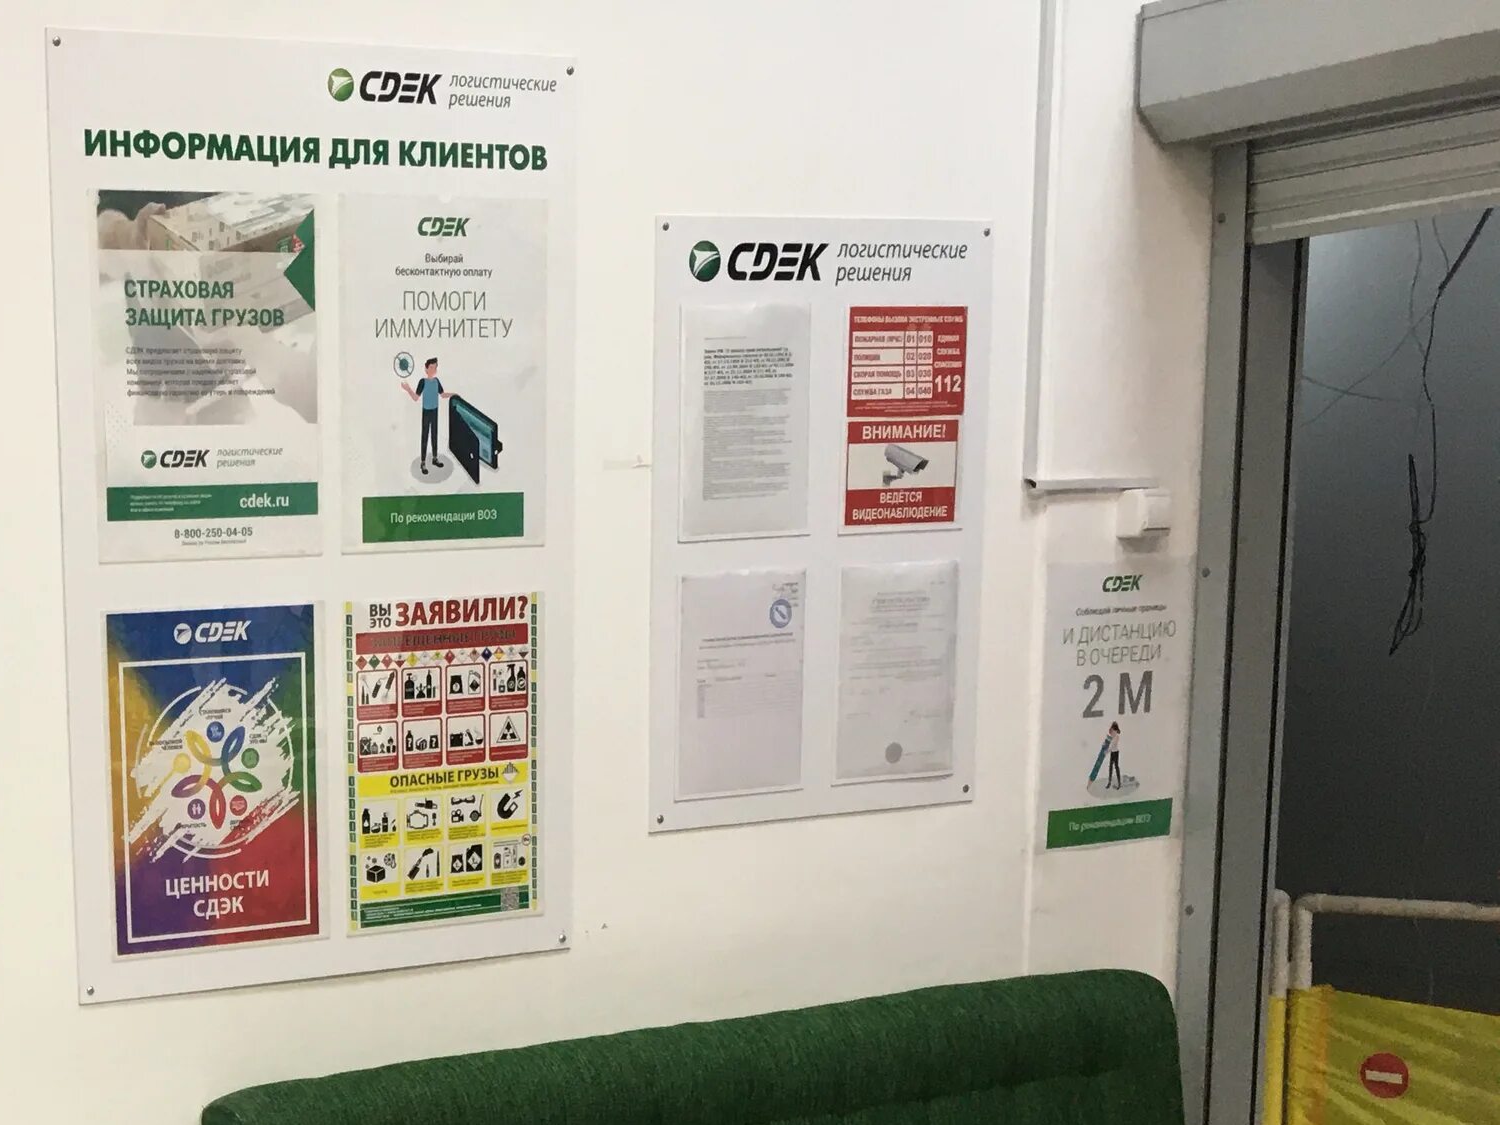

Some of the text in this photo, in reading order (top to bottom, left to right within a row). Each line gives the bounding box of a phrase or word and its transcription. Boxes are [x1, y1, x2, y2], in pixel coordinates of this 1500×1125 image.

[359, 70, 443, 105] CDEK
[449, 72, 557, 94] логистические
[448, 92, 512, 110] решения
[84, 128, 548, 170] ИНФОРМАЦИЯ ДЛЯ КЛИЕНТОВ
[417, 216, 470, 237] CDEK
[425, 253, 464, 266] Выбирай
[837, 241, 968, 260] логистические
[727, 242, 829, 281] CDEK
[395, 267, 493, 278] бесконтактную оплату
[835, 264, 912, 287] решения
[124, 279, 234, 299] СТРАХОВАЯ
[402, 290, 486, 311] ПОМОГИ
[125, 308, 285, 330] ЗАЩИТА ГРУЗОВ
[375, 318, 513, 339] ИММУНИТЕТУ
[934, 374, 962, 393] 112
[862, 424, 946, 440] ВНИМАНИЕ!
[160, 449, 210, 468] CDEK
[240, 493, 289, 510] cdek.ru
[390, 509, 498, 526] По рекомендации ВОЗ
[852, 505, 948, 521] ВИДЕОНАБЛЮДЕНИЕ
[174, 526, 253, 540] 8-800-250-04-05
[1102, 575, 1143, 592] CDEK
[369, 603, 392, 618] ВЫ
[395, 595, 529, 627] ЗАЯВИЛИ?
[194, 620, 252, 643] CDEK
[369, 617, 392, 628] ЭТО
[1063, 620, 1177, 646] И ДИСТАНЦИЮ
[1076, 644, 1161, 666] В ОЧЕРЕДИ
[1082, 674, 1104, 719] 2
[390, 771, 455, 789] ОПАСНЫЕ
[457, 766, 500, 784] ГРУЗЫ
[165, 868, 270, 900] ЦЕННОСТИ
[193, 895, 244, 920] СДЭК
